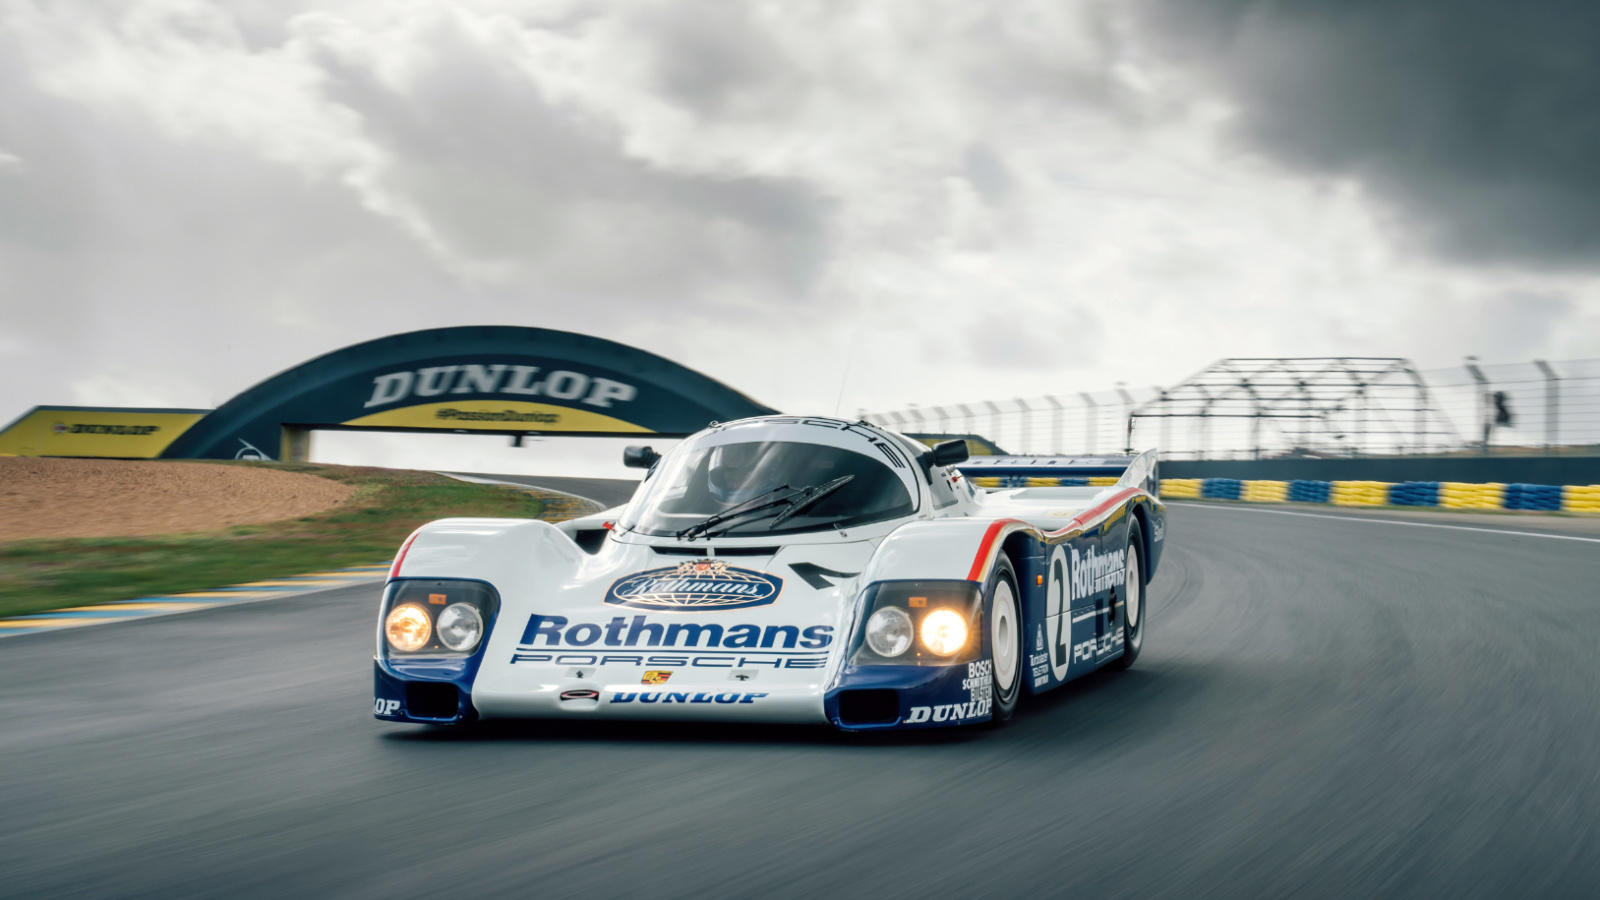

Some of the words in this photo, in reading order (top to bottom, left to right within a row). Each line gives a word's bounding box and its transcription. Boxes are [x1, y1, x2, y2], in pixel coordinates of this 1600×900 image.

[364, 364, 637, 408] DUNLOP
[1071, 544, 1126, 600] Rothmans
[623, 577, 765, 598] Rothmans
[1053, 558, 1067, 668] 2
[520, 613, 835, 649] Rothmans
[1073, 626, 1125, 664] PORSCHE
[509, 653, 830, 669] PORSCHE
[968, 659, 992, 678] BOSCH
[609, 692, 769, 704] DUNLOP
[904, 700, 992, 723] DUNLOP
